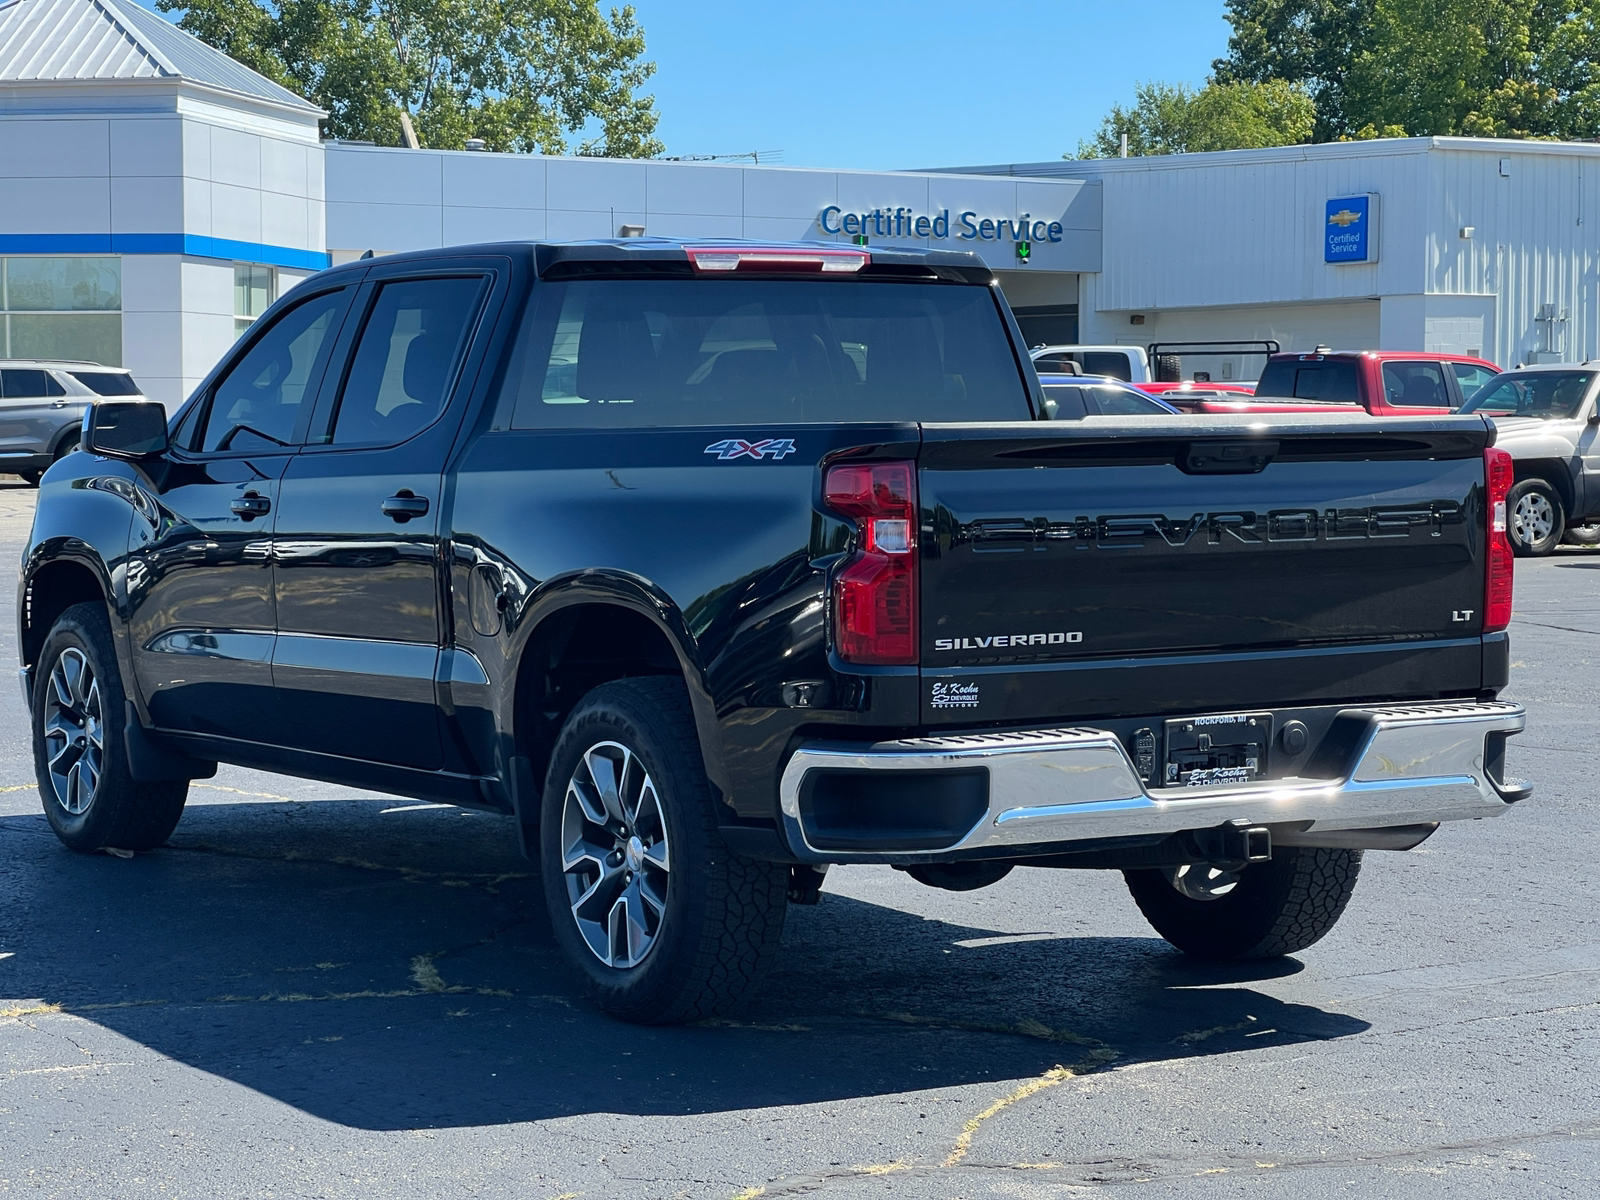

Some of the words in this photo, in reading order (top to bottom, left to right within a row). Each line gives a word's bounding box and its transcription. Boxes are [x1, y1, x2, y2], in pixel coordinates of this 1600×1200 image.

[821, 206, 949, 239] Certified
[960, 211, 1063, 243] Service
[1328, 232, 1360, 244] Certified
[1331, 243, 1358, 253] Service
[971, 499, 1460, 553] CHEVROLET
[1452, 610, 1474, 621] LT
[934, 631, 1083, 651] SILVERADO
[931, 682, 948, 695] Ed
[950, 694, 978, 702] CHEVROLET
[1190, 768, 1208, 781] Ed
[1203, 776, 1249, 787] CHEVROLET
